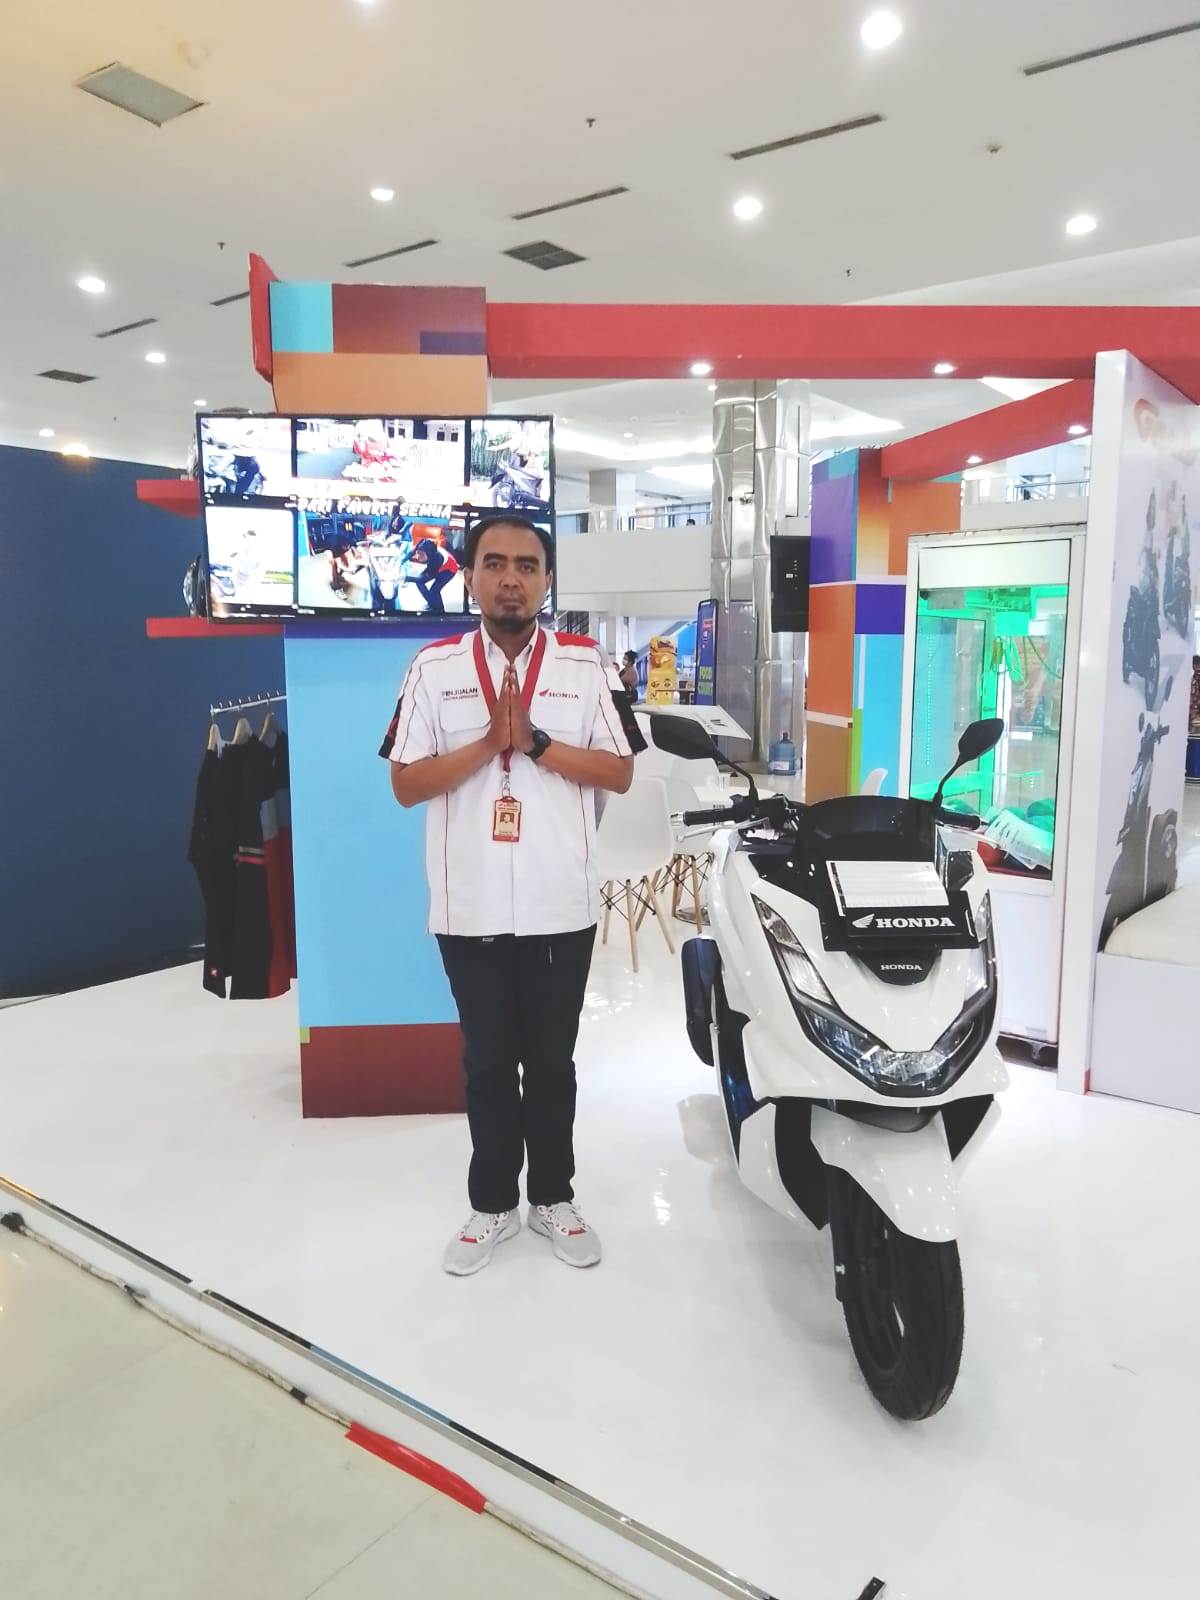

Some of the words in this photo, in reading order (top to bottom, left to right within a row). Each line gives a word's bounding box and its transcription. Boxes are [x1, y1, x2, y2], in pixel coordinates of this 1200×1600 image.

[441, 687, 478, 697] PENJUALAN
[549, 692, 579, 700] HONDA
[875, 917, 956, 929] HONDA
